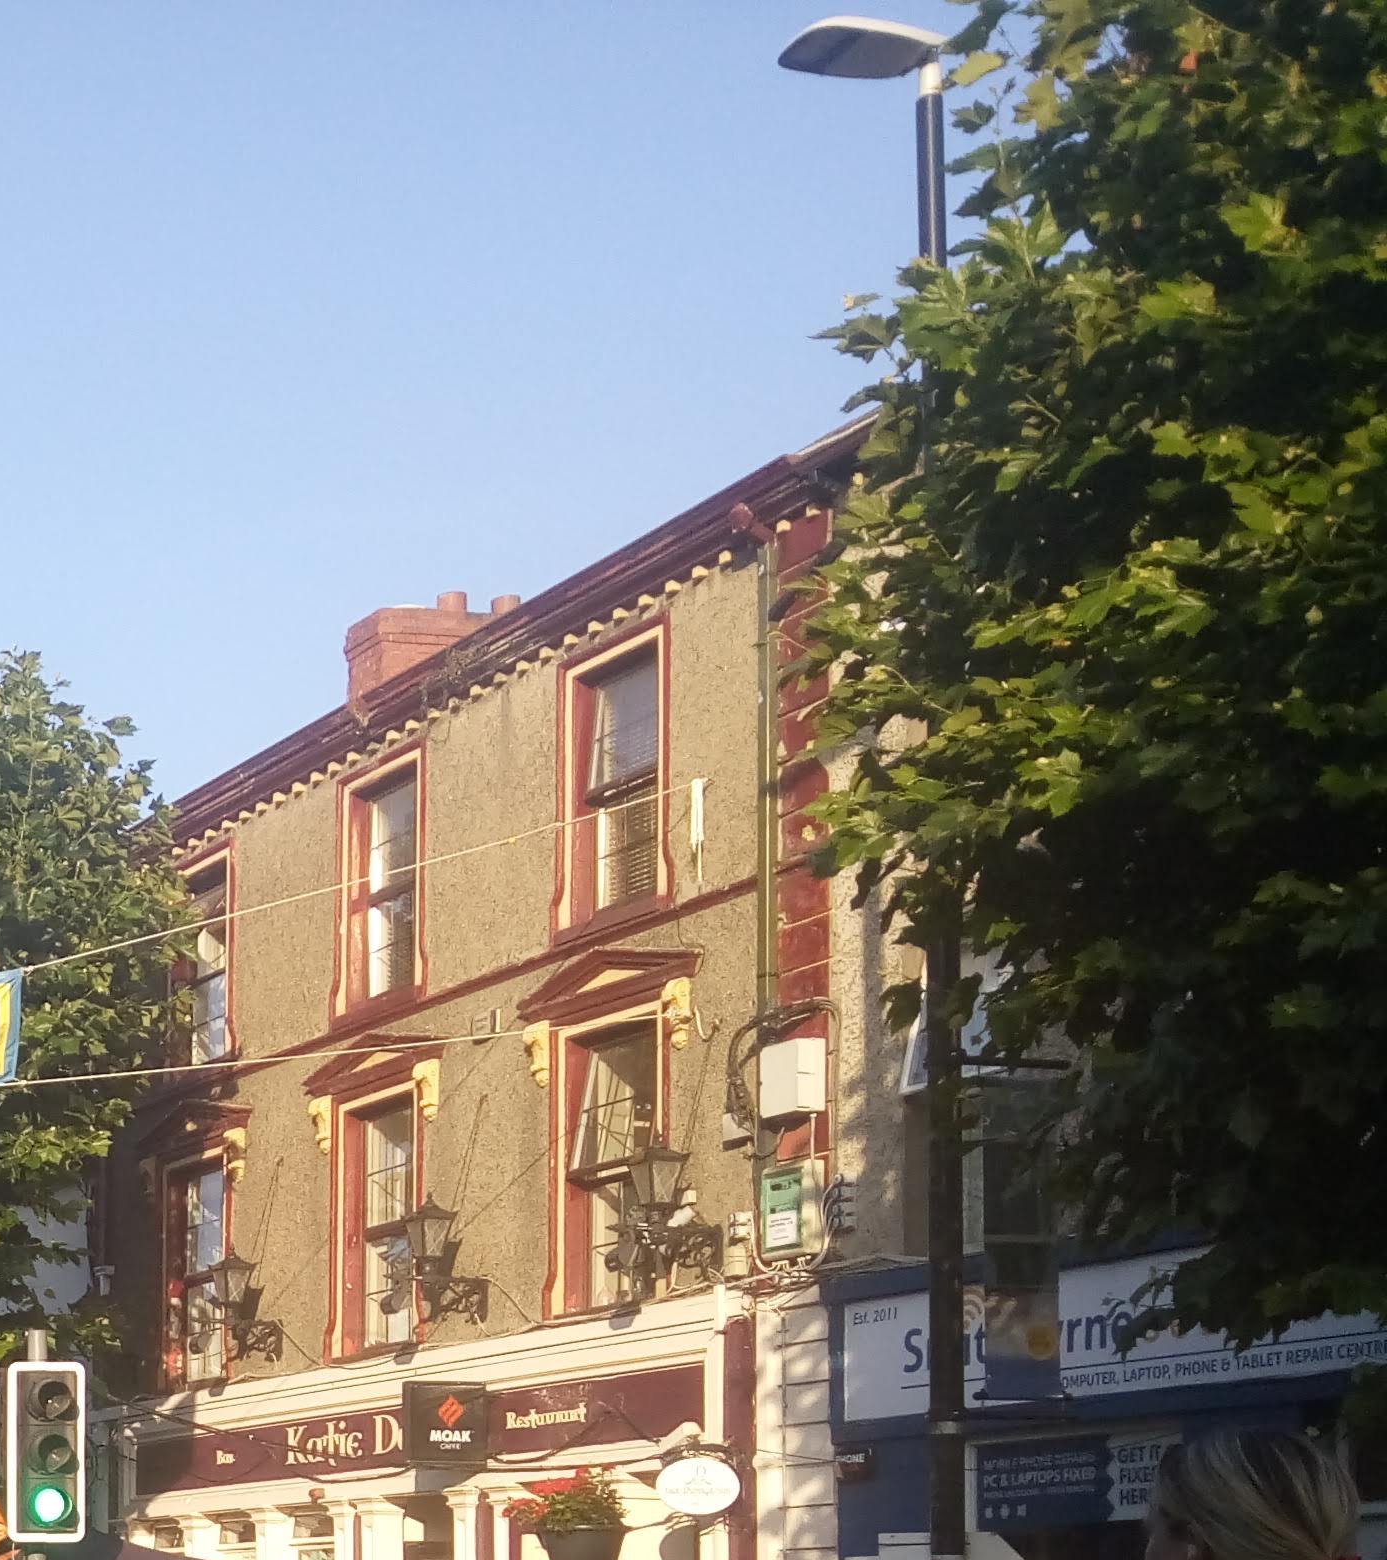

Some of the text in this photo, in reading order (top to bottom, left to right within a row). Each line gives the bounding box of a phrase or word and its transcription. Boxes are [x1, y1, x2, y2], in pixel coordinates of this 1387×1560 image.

[853, 1307, 898, 1326] Est. 2011
[1061, 1374, 1120, 1389] OMPUTER,
[1123, 1367, 1172, 1384] LAPTOP,
[1174, 1361, 1218, 1376] PHONE
[1233, 1351, 1282, 1371] TABLET
[1286, 1345, 1333, 1364] REPAIR
[505, 1402, 587, 1430] Restaurant
[284, 1420, 364, 1467] Katie
[430, 1430, 472, 1443] MOAK
[1118, 1444, 1162, 1463] GET IT
[983, 1473, 997, 1488] PC
[1012, 1469, 1061, 1486] LAPTOPS
[1063, 1466, 1097, 1482] FIXED
